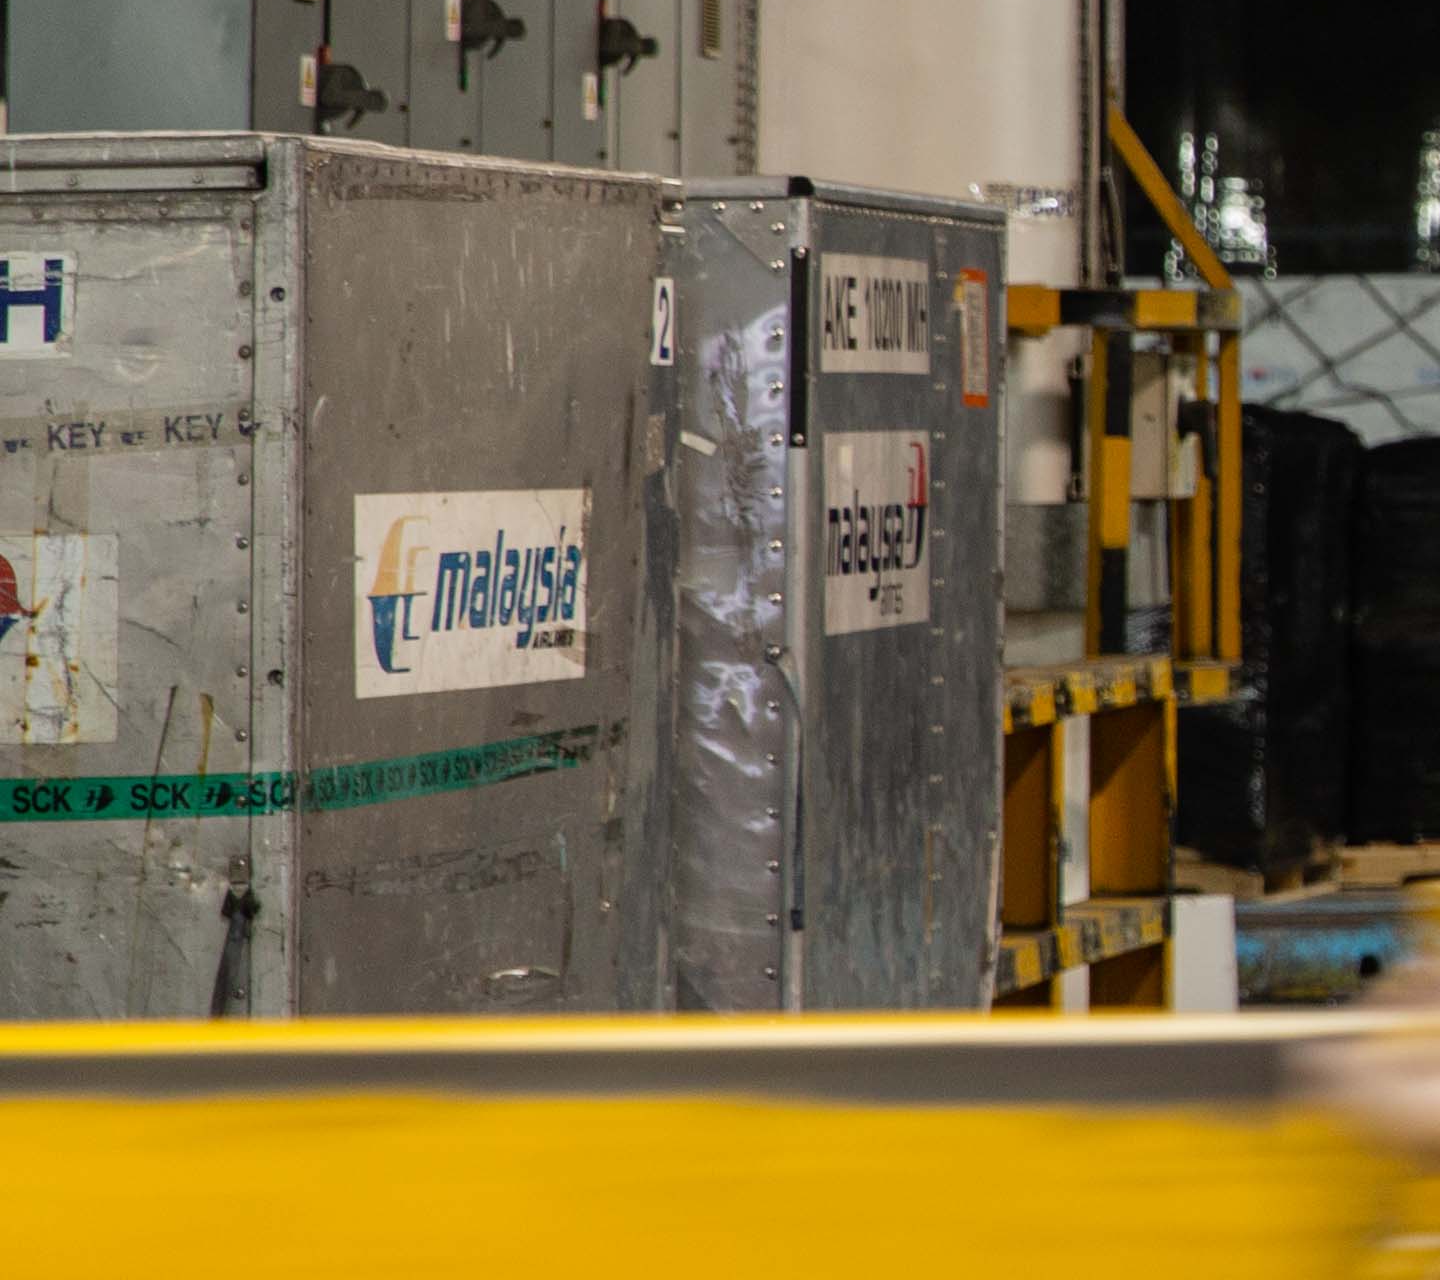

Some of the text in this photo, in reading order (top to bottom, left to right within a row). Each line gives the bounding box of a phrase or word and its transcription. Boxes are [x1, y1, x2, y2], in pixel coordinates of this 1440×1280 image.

[658, 285, 670, 359] 2
[824, 275, 857, 351] AKE
[47, 414, 223, 451] KEY KEY
[431, 525, 582, 650] malaysia
[12, 785, 72, 814] SCK
[130, 782, 192, 811] SCK
